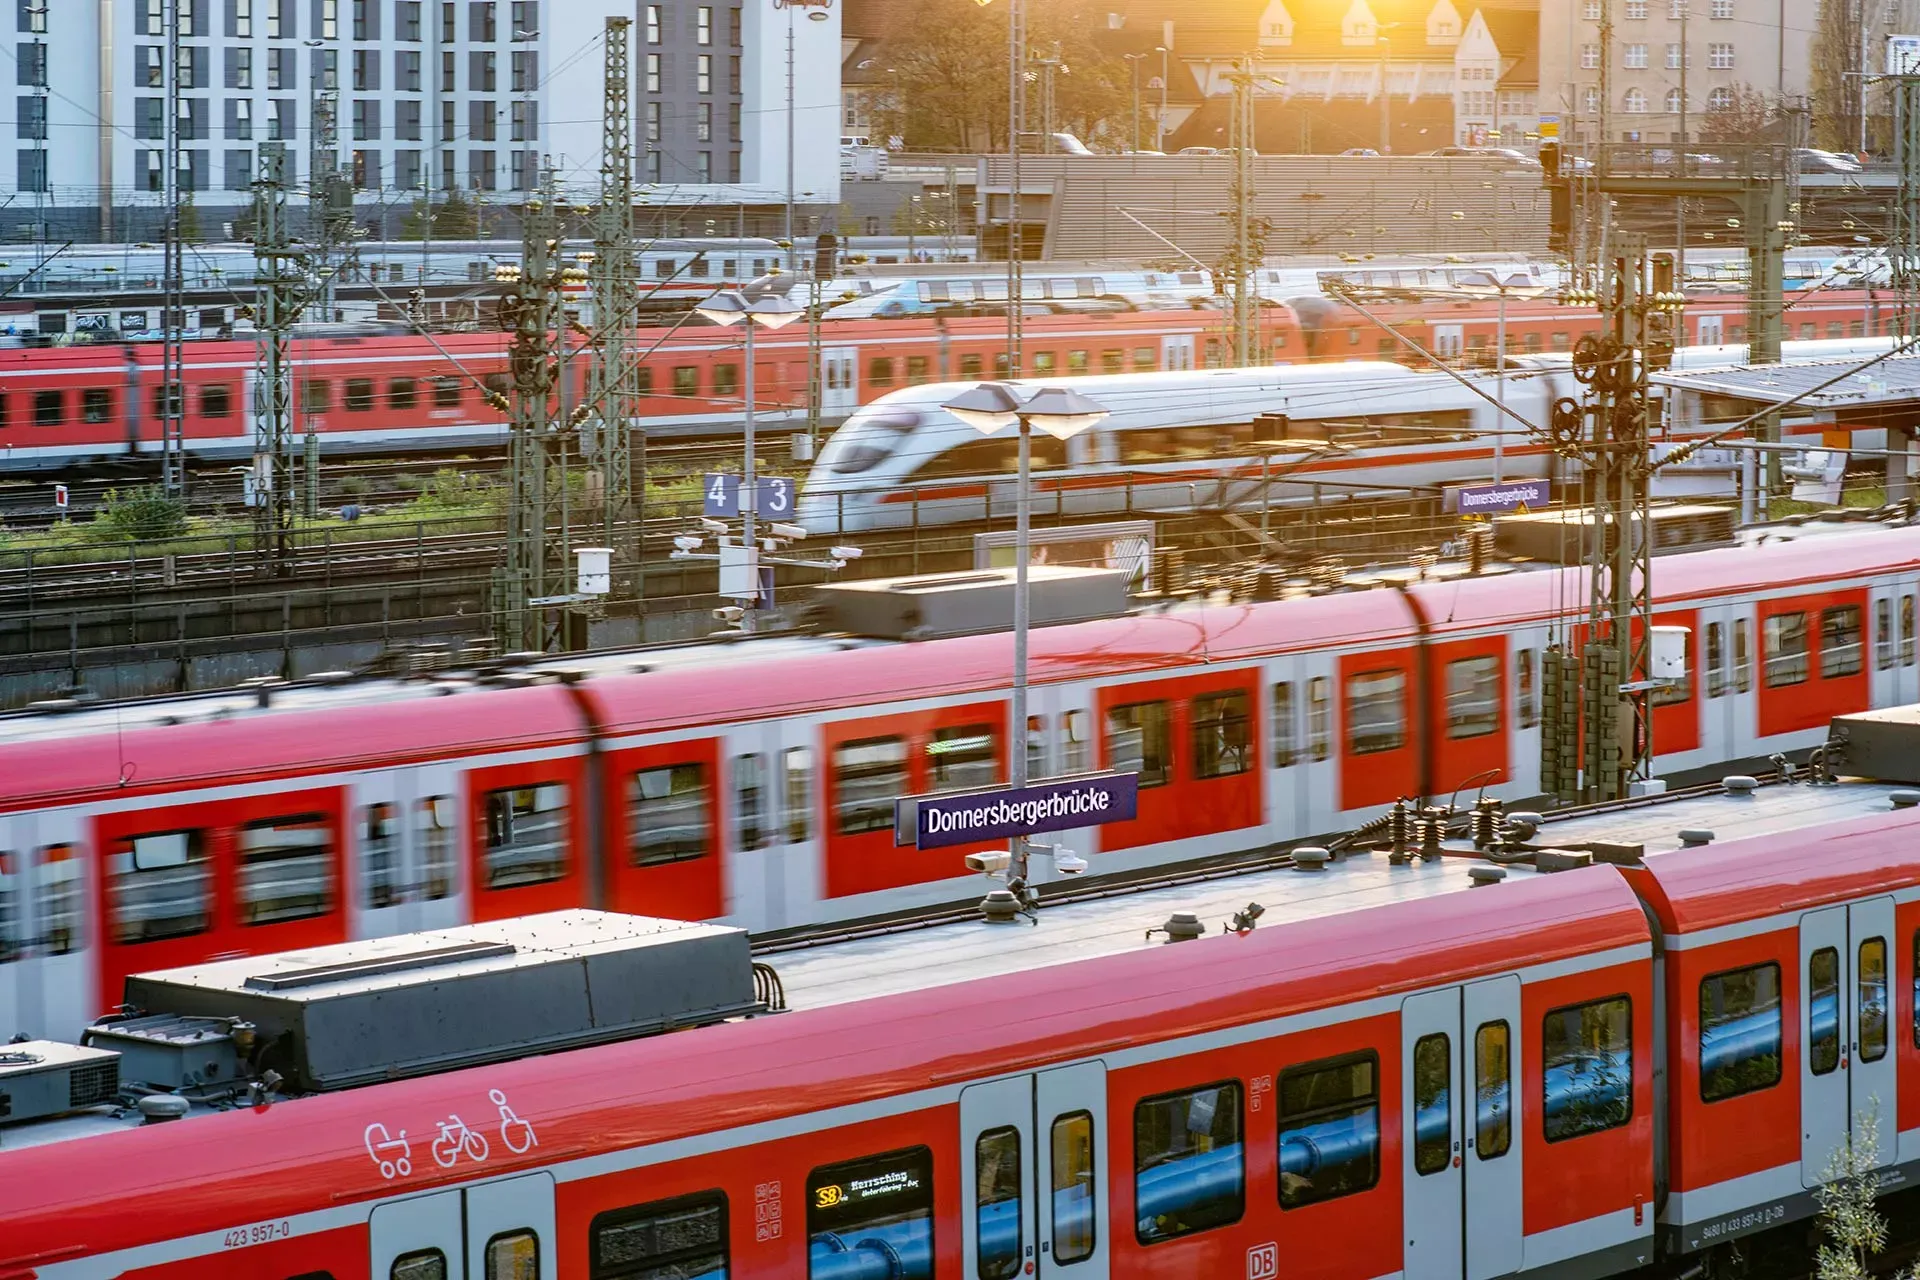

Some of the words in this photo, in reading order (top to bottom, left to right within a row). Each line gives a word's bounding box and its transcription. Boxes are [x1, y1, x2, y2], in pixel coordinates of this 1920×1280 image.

[708, 476, 727, 507] 4
[769, 479, 787, 511] 3
[1462, 486, 1539, 506] Donnersbergerbrücke
[928, 787, 1109, 833] Donnersbergerbrücke
[851, 1172, 908, 1191] Herrsching
[819, 1188, 837, 1205] S8
[224, 1229, 247, 1248] 423
[251, 1221, 289, 1243] 957-0
[1251, 1249, 1274, 1277] DB
